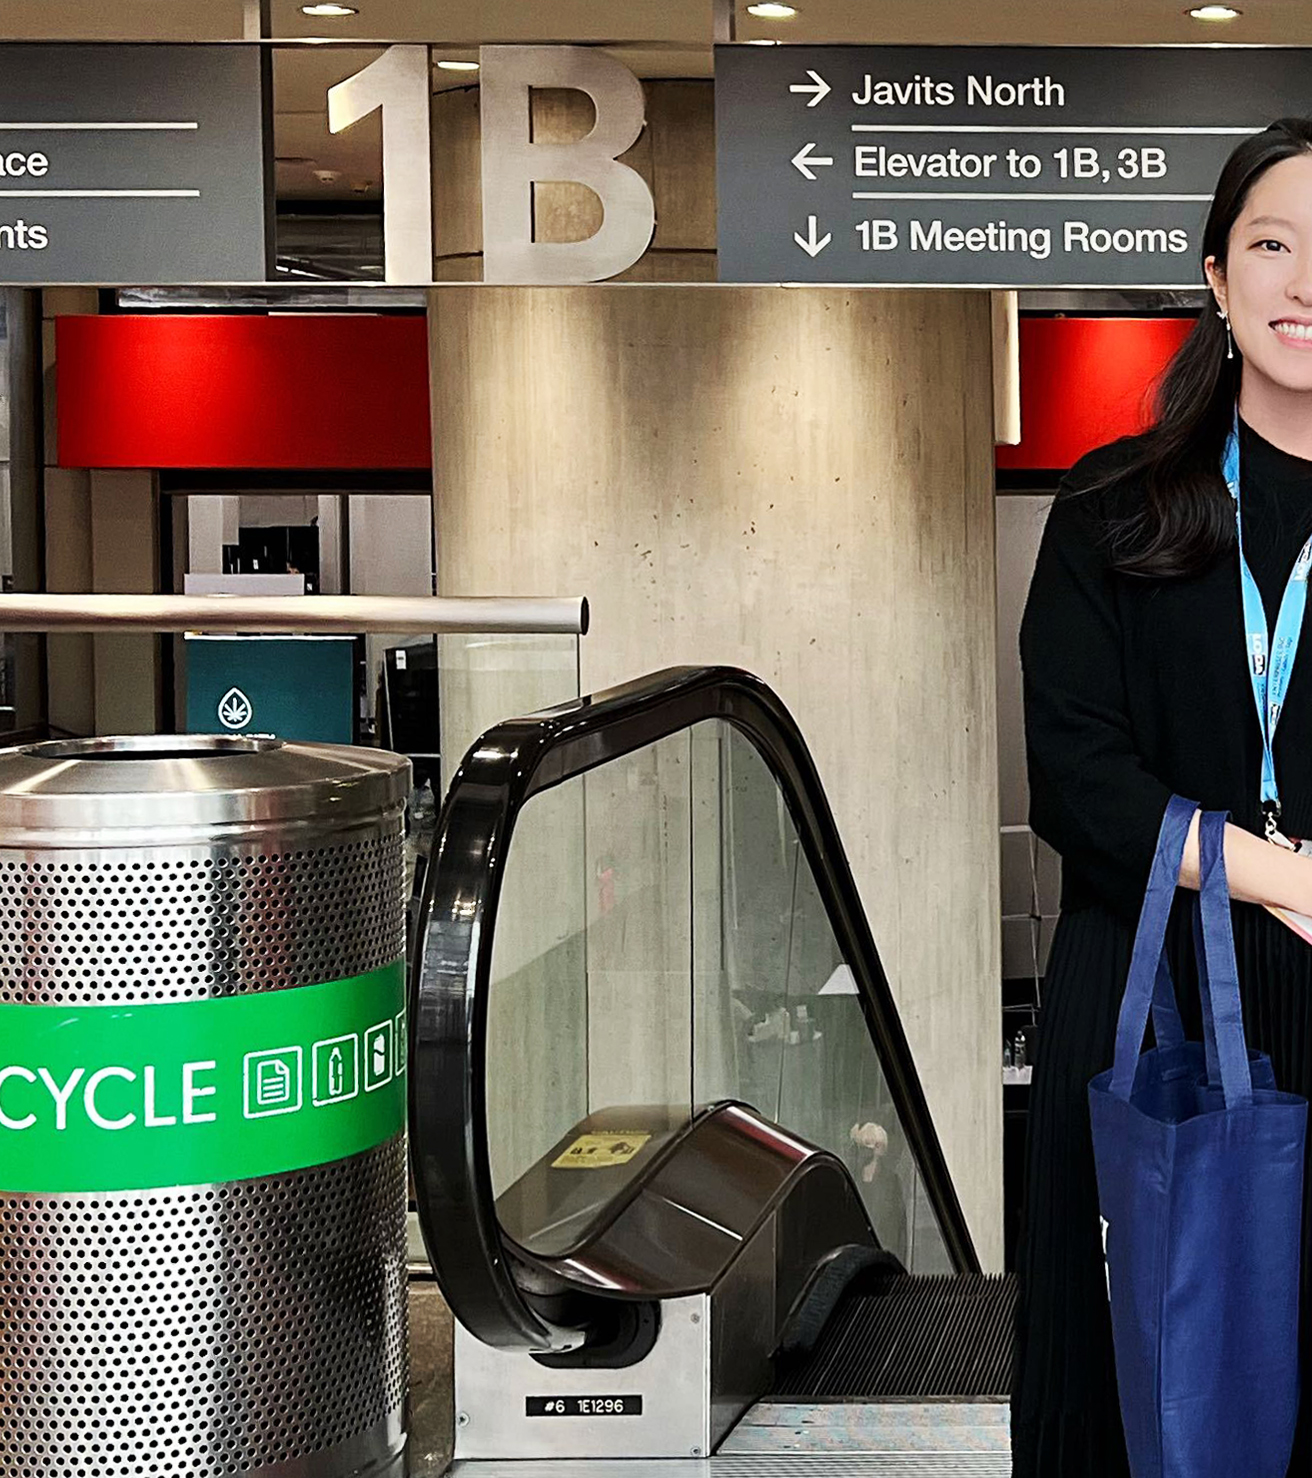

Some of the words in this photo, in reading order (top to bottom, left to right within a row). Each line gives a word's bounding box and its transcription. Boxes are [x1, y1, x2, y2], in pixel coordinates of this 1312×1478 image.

[852, 75, 954, 105] Javits
[967, 75, 1065, 106] North
[327, 45, 655, 283] 1B
[855, 146, 997, 177] Elevator
[1006, 149, 1042, 178] to
[855, 220, 898, 251] 1B
[910, 220, 1051, 260] Meeting
[1064, 221, 1188, 253] Rooms
[0, 1060, 216, 1130] CYCLE
[544, 1400, 565, 1413] #6
[577, 1399, 624, 1413] 1E1296
